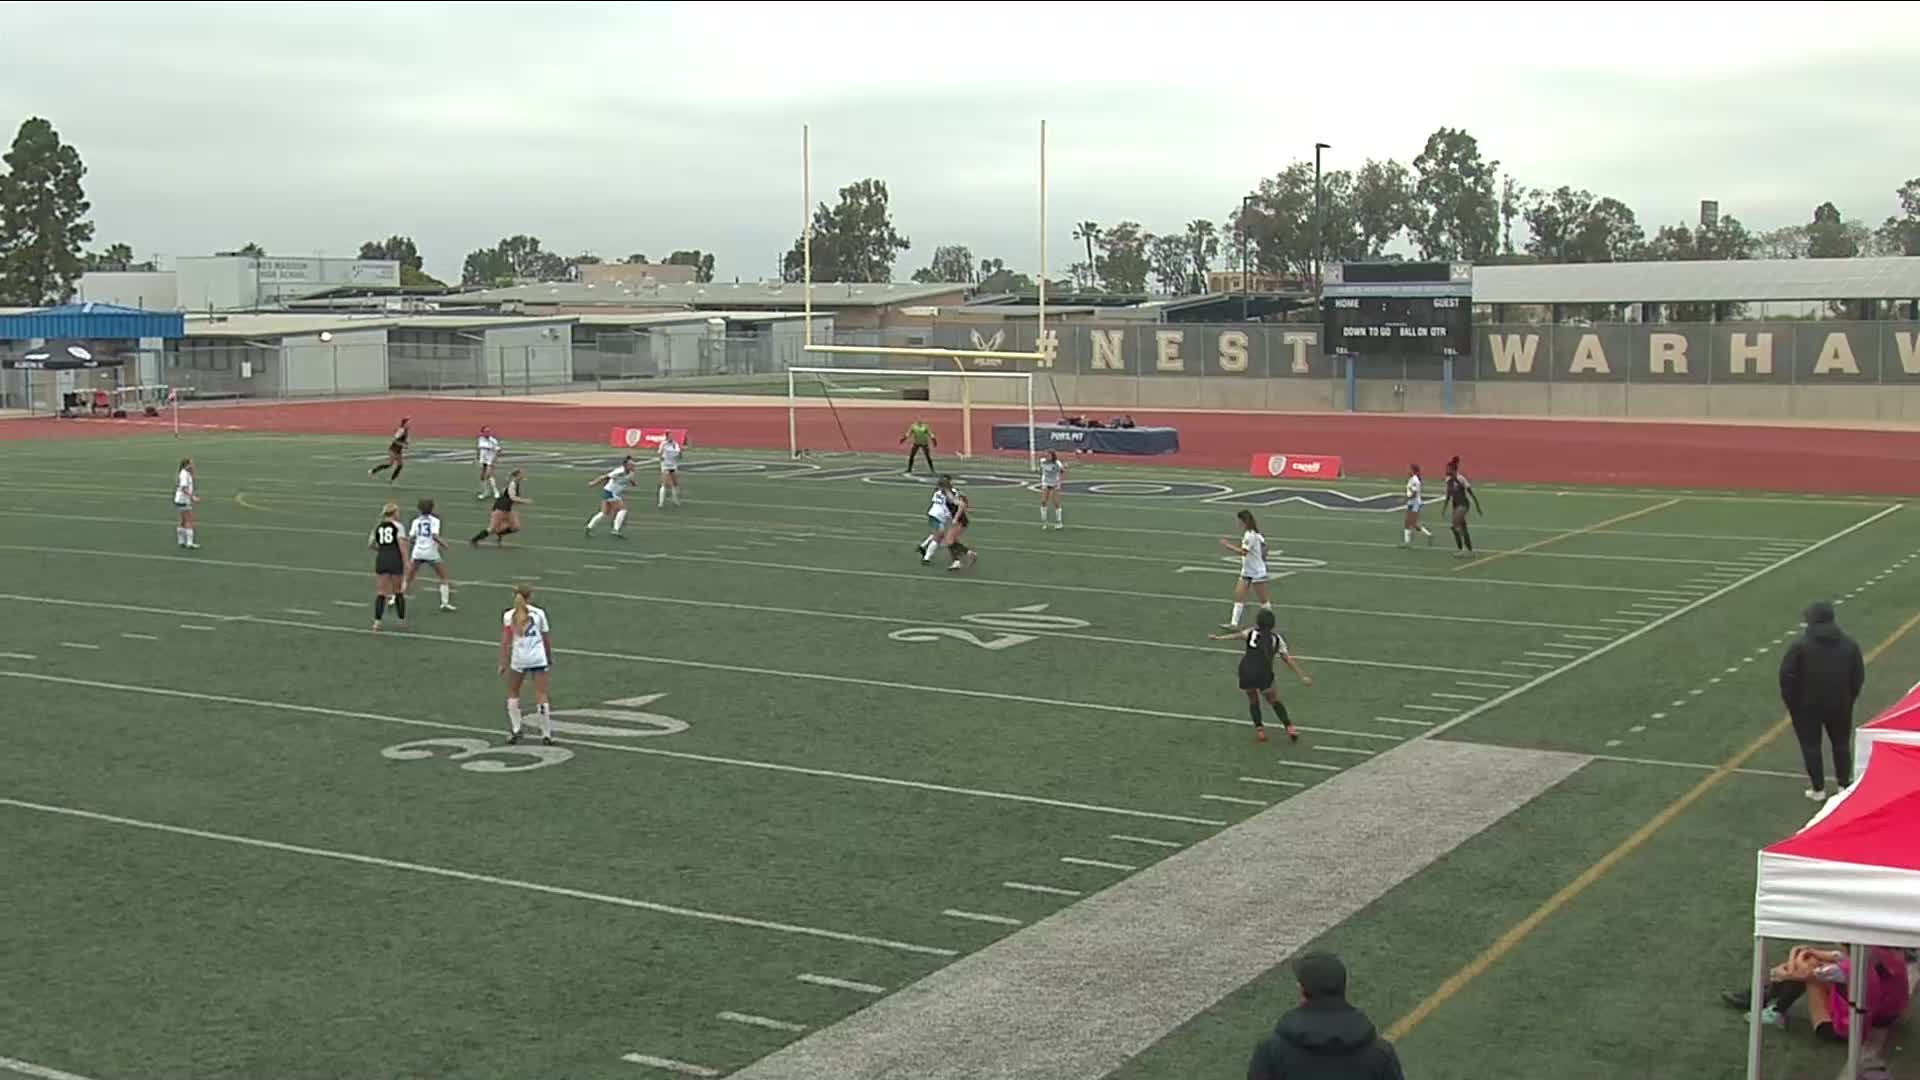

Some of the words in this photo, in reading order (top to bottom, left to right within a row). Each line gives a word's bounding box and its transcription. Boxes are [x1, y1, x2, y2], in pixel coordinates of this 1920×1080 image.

[1335, 299, 1360, 308] HOME
[1433, 298, 1459, 308] GUEST
[1343, 326, 1367, 337] DOWN
[1369, 326, 1379, 337] TO
[1379, 326, 1392, 337] GO
[1399, 326, 1417, 337] BALL
[1417, 326, 1428, 337] ON
[1430, 326, 1447, 337] QTR
[1036, 329, 1317, 373] #NEST
[378, 526, 394, 545] 18
[418, 522, 432, 538] 13
[887, 612, 1092, 650] 20
[380, 708, 691, 773] 30
